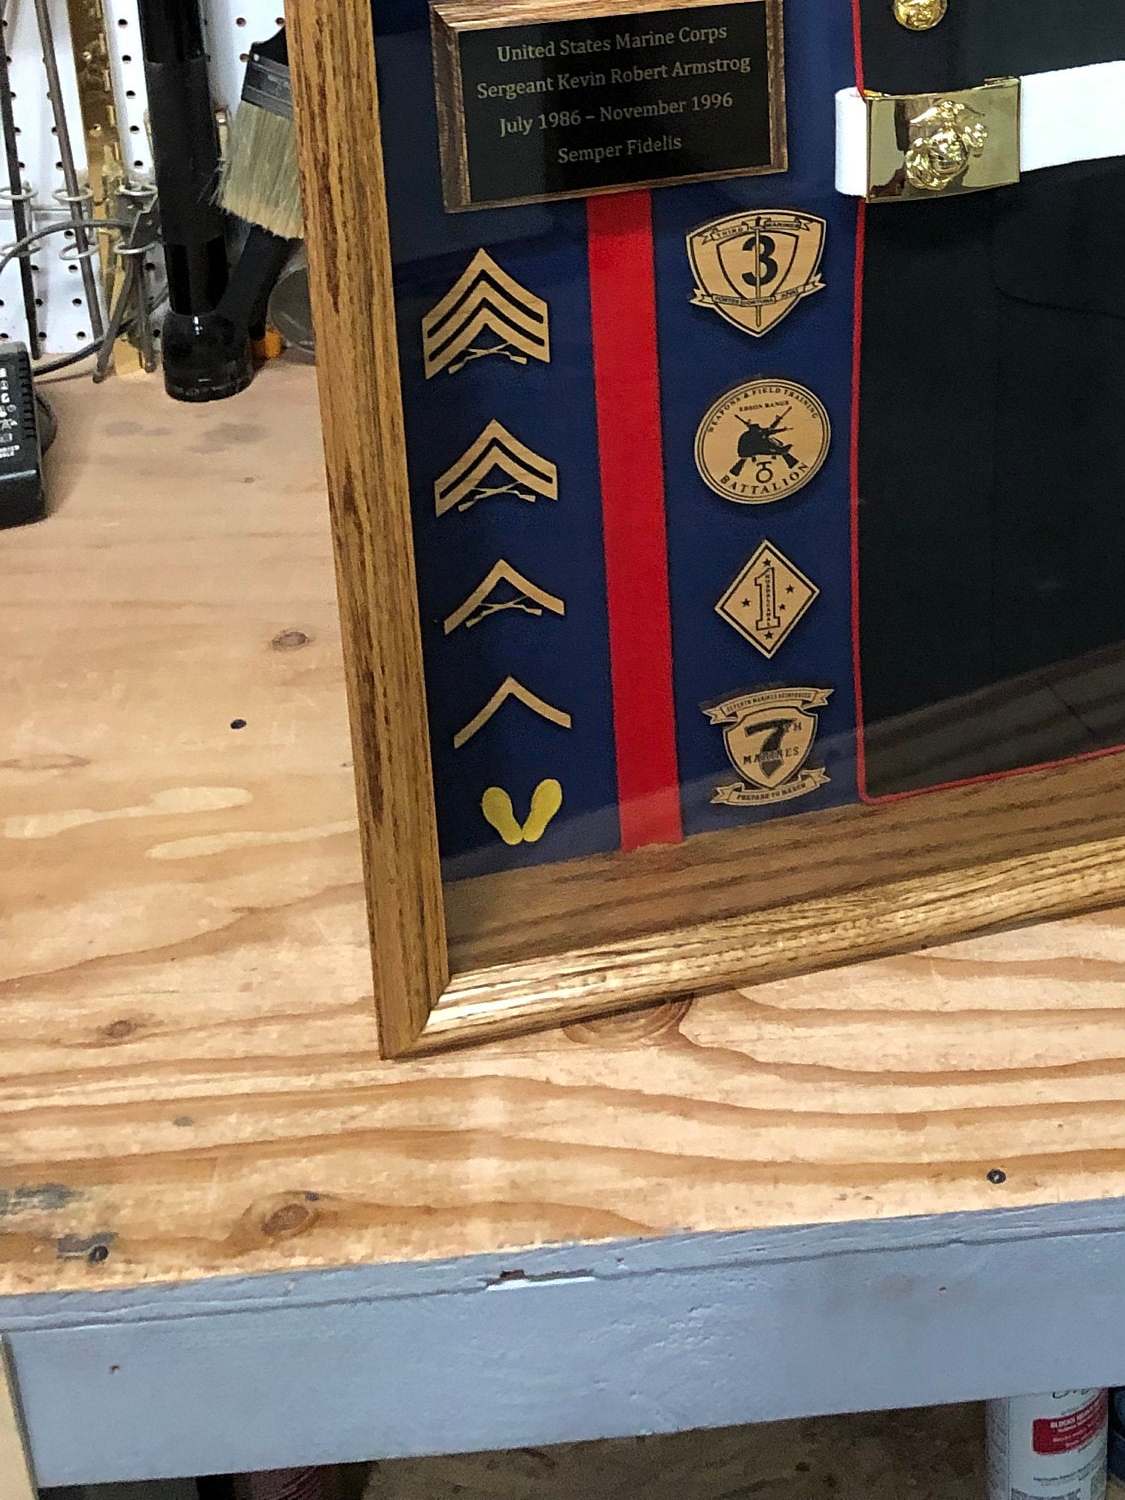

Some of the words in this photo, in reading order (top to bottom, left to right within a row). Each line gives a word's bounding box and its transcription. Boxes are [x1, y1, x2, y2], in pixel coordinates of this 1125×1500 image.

[497, 38, 555, 62] United
[559, 38, 611, 56] States
[615, 30, 675, 50] Marine
[678, 25, 728, 48] Corps
[477, 76, 554, 100] Sergeant
[557, 71, 606, 90] Kevin
[610, 63, 669, 84] Robert
[671, 56, 752, 78] Armstrog
[499, 116, 534, 137] July
[538, 109, 581, 129] 1986
[599, 98, 687, 123] November
[691, 91, 734, 111] 1996
[557, 144, 623, 164] Semper
[626, 135, 683, 157] Fidelis
[717, 227, 744, 238] THIRD
[741, 234, 778, 287] 3
[708, 396, 742, 433] WEAPONS
[752, 387, 782, 396] FIELD
[784, 389, 818, 419] TRAINING
[720, 463, 810, 495] BATTALION
[743, 746, 799, 765] MARINES
[744, 717, 798, 779] 7
